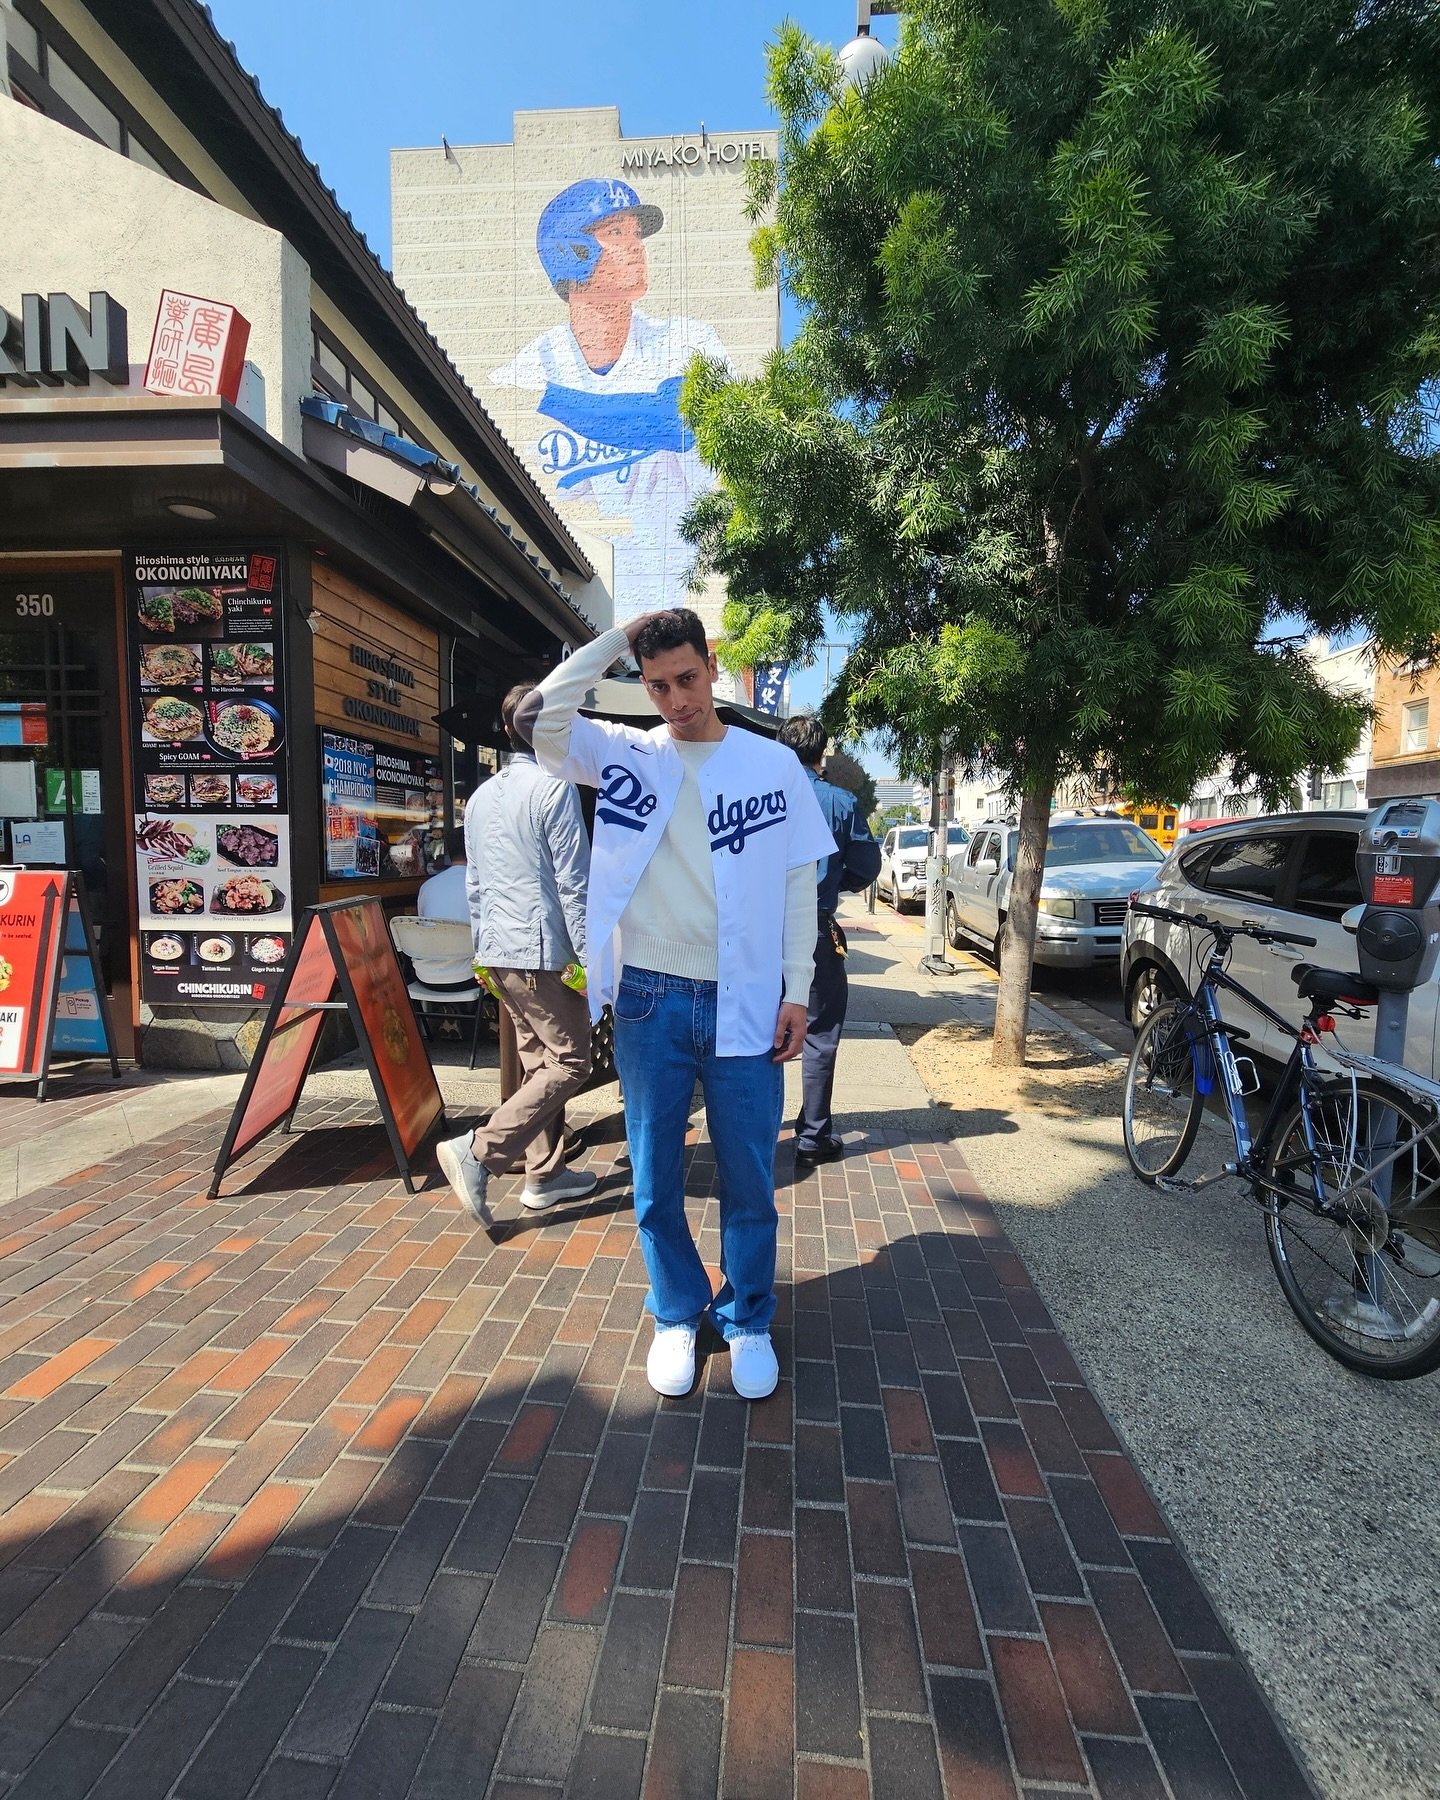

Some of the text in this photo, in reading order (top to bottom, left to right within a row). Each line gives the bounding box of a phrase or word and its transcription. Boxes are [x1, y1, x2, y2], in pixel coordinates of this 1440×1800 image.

[621, 142, 769, 168] MIYAKO HOTEL
[606, 180, 630, 207] LA
[135, 555, 209, 566] Hiroshima style
[135, 565, 248, 581] OKONOMIYAKI
[16, 594, 54, 617] 350
[227, 597, 272, 606] Chinchikurin
[227, 605, 243, 614] yaki
[350, 643, 415, 689] HIROSHIMA
[367, 678, 402, 707] STYLE
[159, 753, 177, 762] Spicy
[333, 757, 367, 777] 2018 NYC
[376, 754, 410, 772] HIROSHIMA
[54, 779, 76, 805] A
[329, 778, 372, 798] CHAMPIONS!
[596, 764, 657, 818] Do
[707, 789, 787, 855] dgers
[15, 834, 32, 844] LA
[0, 914, 36, 927] KURIN
[177, 983, 251, 995] CHINCHIKURIN
